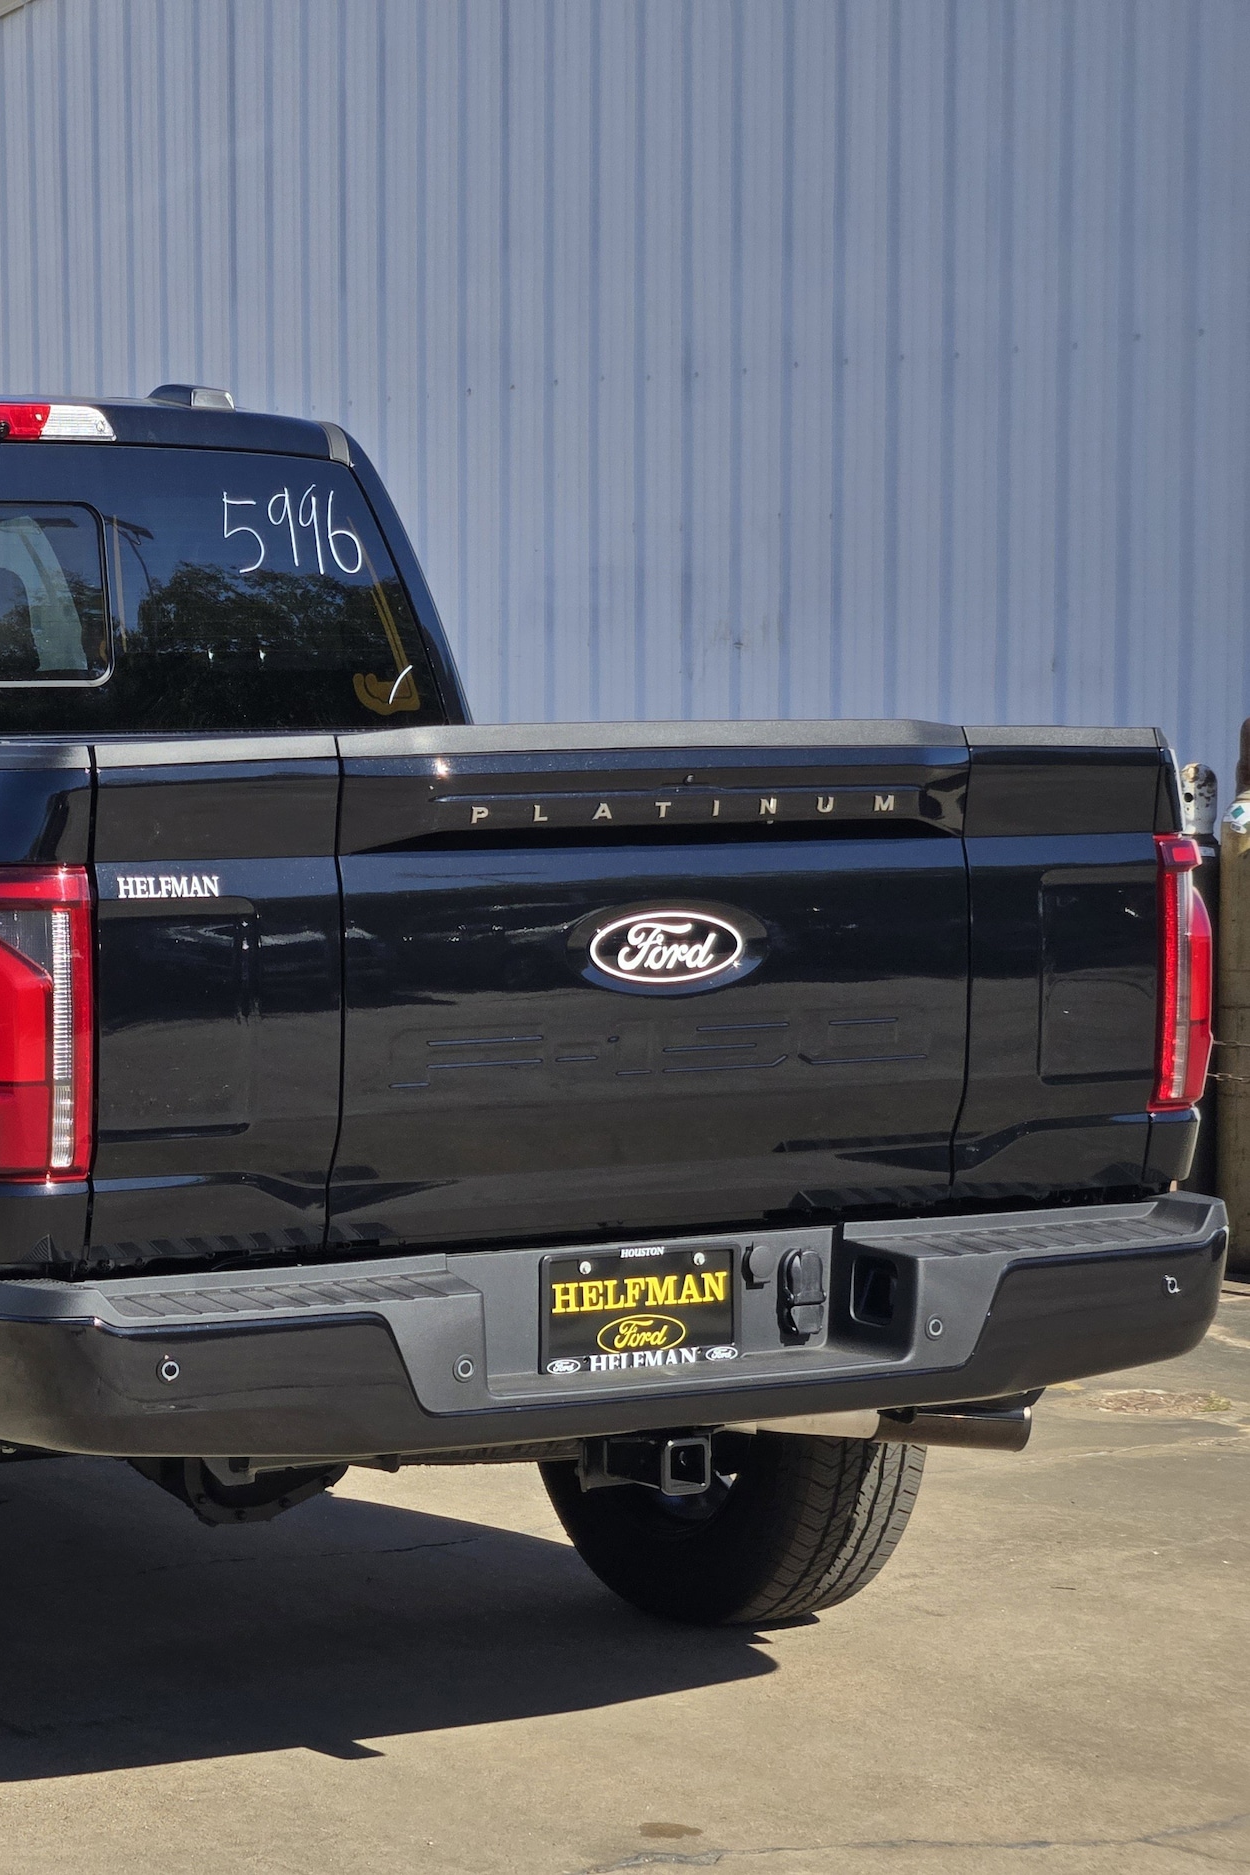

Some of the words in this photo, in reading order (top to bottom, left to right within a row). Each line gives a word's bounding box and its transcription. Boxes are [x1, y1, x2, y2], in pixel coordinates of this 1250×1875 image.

[221, 484, 362, 575] 5996
[471, 794, 894, 824] PLATINUM
[117, 875, 220, 898] HELFMAN
[617, 923, 717, 970] Ford
[621, 1247, 665, 1258] HOUSTON
[552, 1272, 728, 1313] HELFMAN
[614, 1319, 668, 1348] Ford
[552, 1361, 576, 1373] Ford
[589, 1347, 700, 1371] HELFMAN
[711, 1348, 734, 1359] Ford
